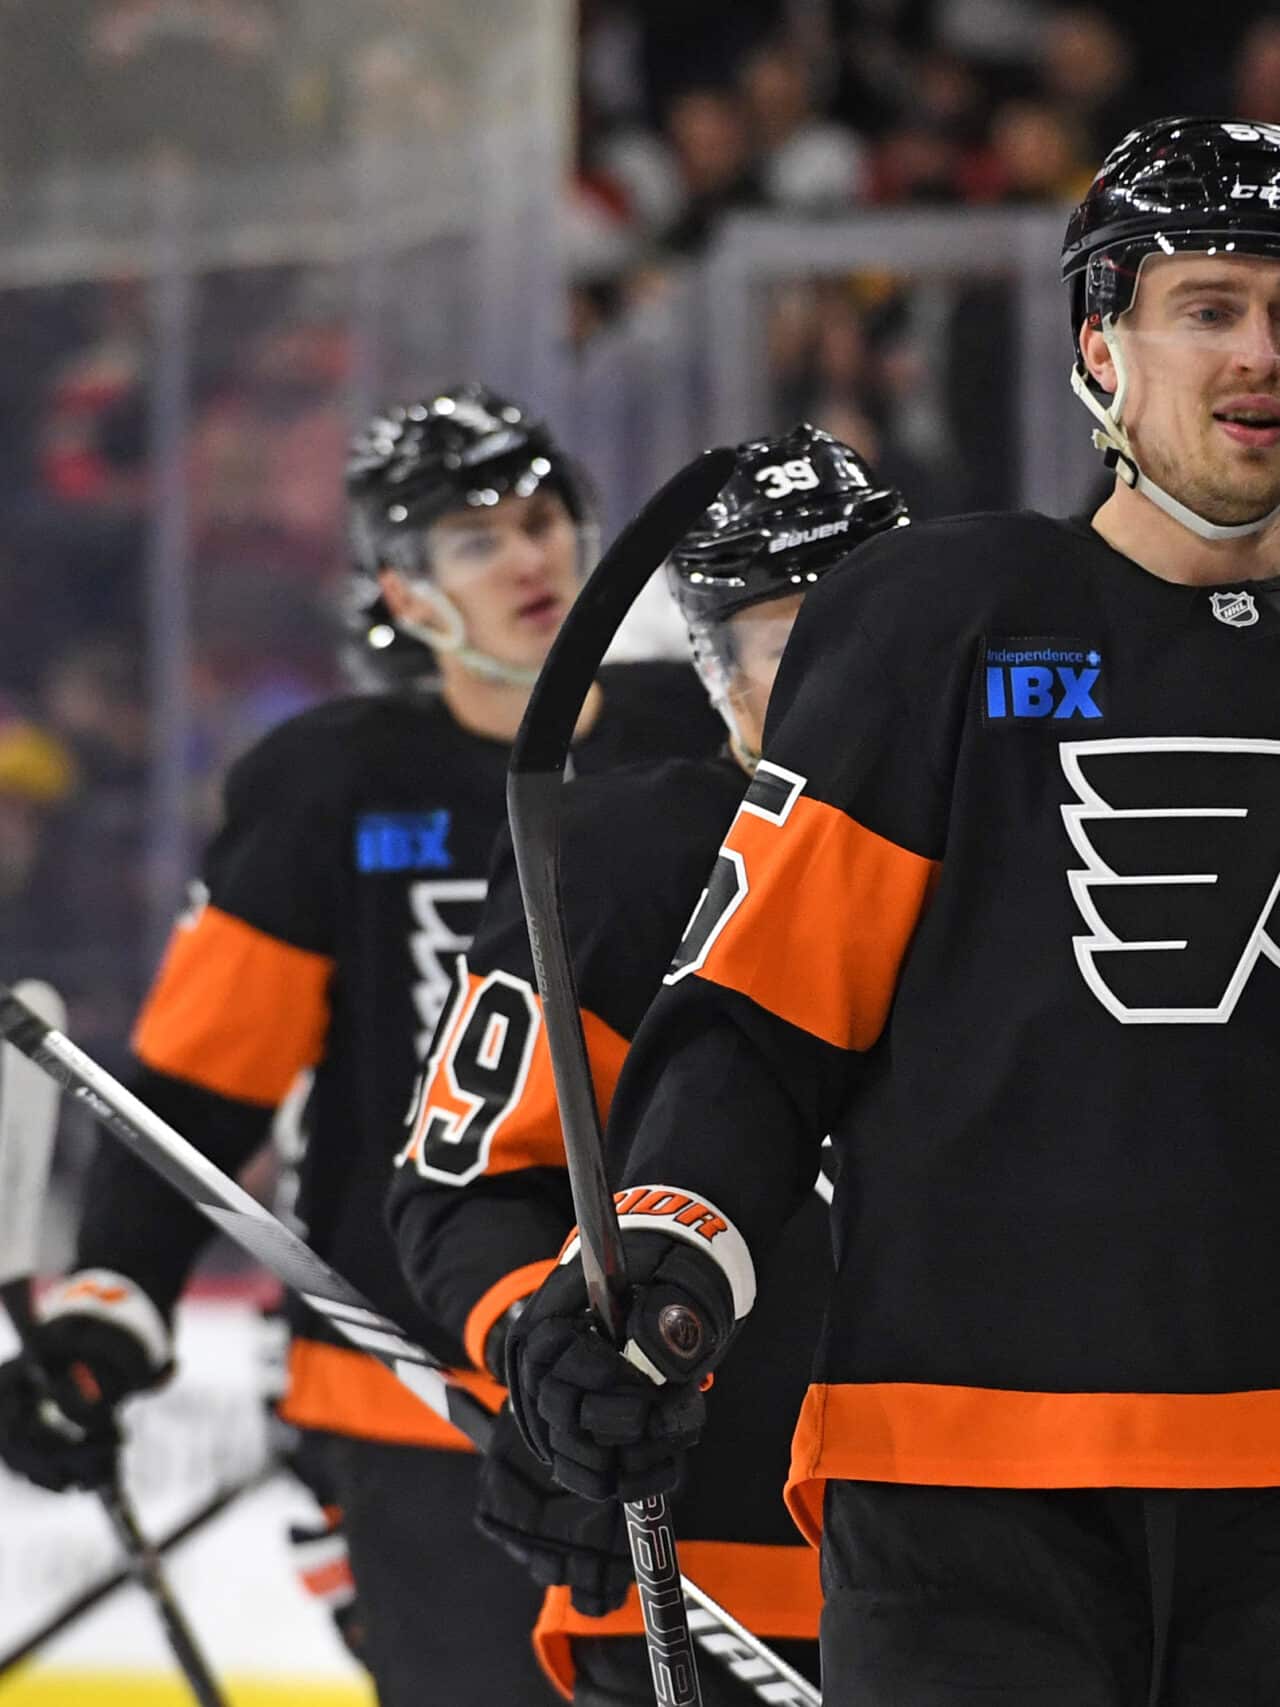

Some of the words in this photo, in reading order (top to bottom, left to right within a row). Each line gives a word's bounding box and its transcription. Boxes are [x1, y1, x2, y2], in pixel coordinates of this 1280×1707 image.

[755, 460, 820, 499] 39
[768, 520, 849, 554] BAUER
[986, 650, 1084, 665] Independence
[986, 667, 1103, 719] IBX
[396, 954, 541, 1187] 9
[614, 1188, 727, 1243] IOR
[623, 1493, 703, 1707] BAUE
